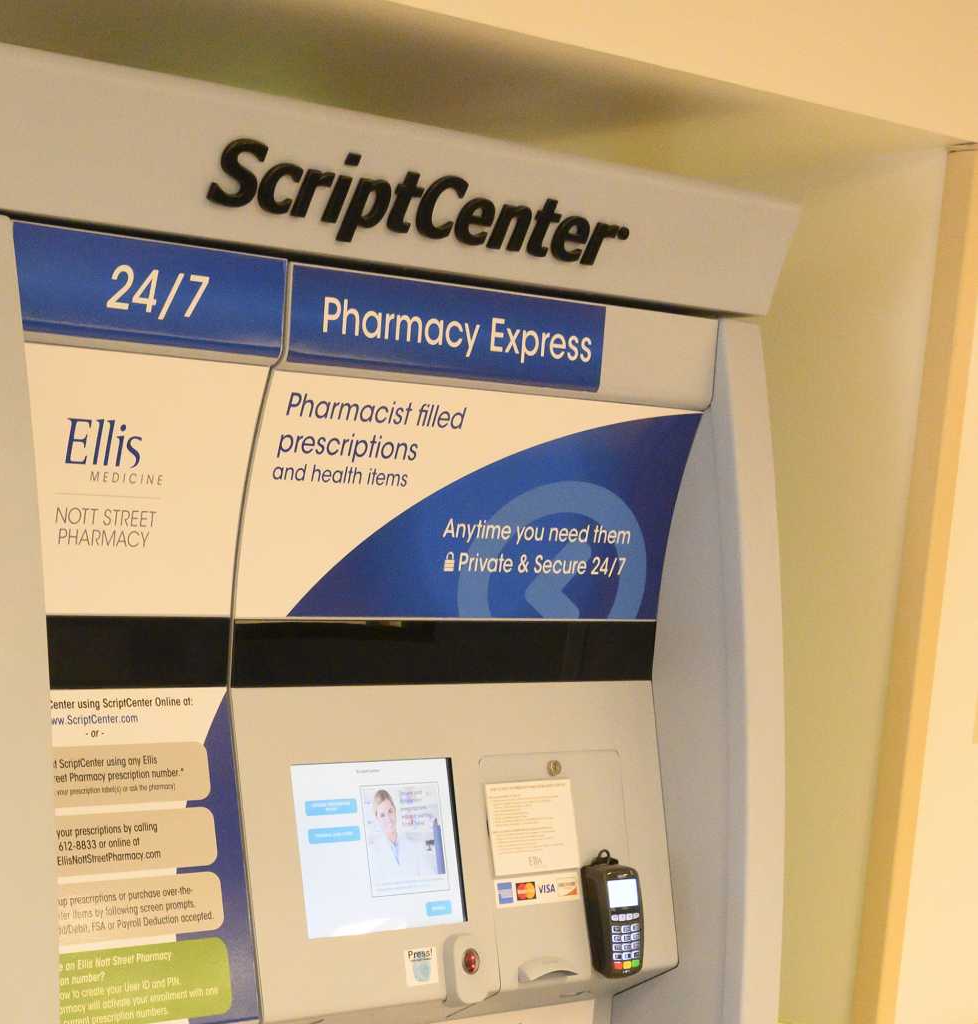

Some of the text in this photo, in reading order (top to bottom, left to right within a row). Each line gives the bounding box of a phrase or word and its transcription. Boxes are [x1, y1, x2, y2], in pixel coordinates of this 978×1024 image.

[206, 137, 622, 266] ScriptCenter
[106, 264, 209, 321] 24/7
[322, 296, 593, 364] Pharmacy Express
[286, 392, 467, 431] Pharmacist filled
[64, 416, 143, 468] Ellis
[276, 431, 419, 464] prescriptions
[90, 470, 164, 487] MEDICINE
[272, 464, 408, 488] and health items
[54, 506, 157, 528] NOTT STREET
[57, 527, 150, 548] PHARMACY
[442, 519, 632, 545] Anytime you need them
[458, 554, 626, 576] Private & Secure 24/7
[50, 696, 193, 711] enter using ScriptCenter Online at:
[90, 730, 99, 739] or
[59, 756, 105, 770] ScriptCenter
[106, 755, 127, 768] using
[128, 756, 141, 767] any
[142, 755, 158, 765] Ellis
[54, 772, 68, 784] eet
[69, 772, 106, 783] Pharmacy
[108, 769, 150, 781] prescription
[56, 822, 158, 838] your prescriptions by calling
[59, 837, 140, 851] 612-8833 or online at
[58, 896, 68, 908] up
[69, 893, 118, 906] prescriptions
[118, 892, 127, 901] or
[127, 890, 161, 901] purchase
[538, 883, 556, 894] VISA
[105, 902, 139, 915] following
[140, 903, 164, 913] screen
[165, 900, 196, 912] prompts.
[92, 920, 106, 932] FSA
[108, 921, 116, 929] or
[117, 918, 142, 929] Payroll
[143, 913, 180, 927] Deduction
[180, 911, 215, 924] accepted.
[136, 950, 172, 963] Pharmacy
